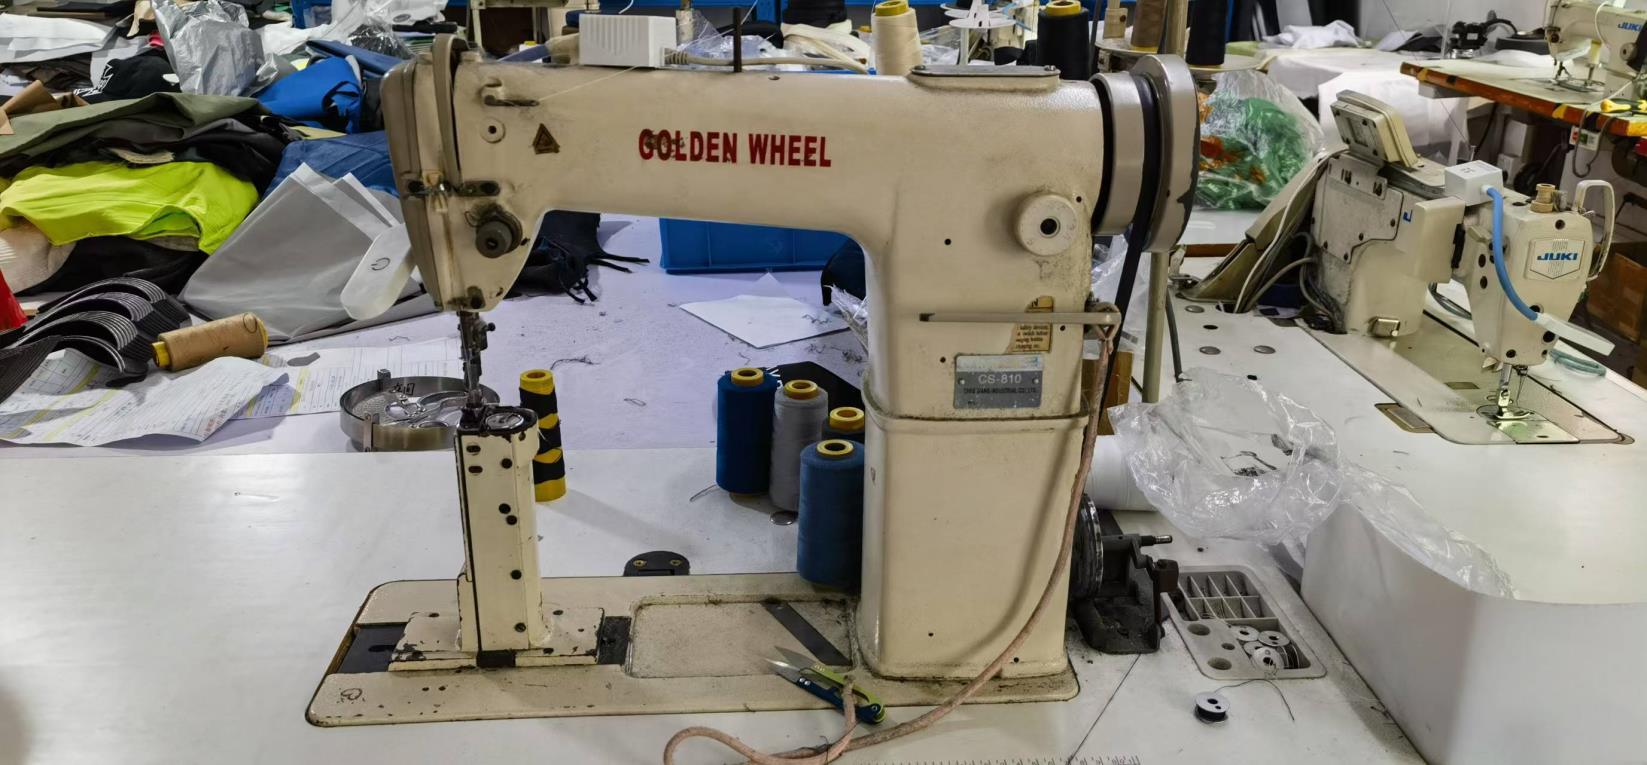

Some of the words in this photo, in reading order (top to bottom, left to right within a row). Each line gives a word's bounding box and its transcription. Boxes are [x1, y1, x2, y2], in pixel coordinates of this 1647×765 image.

[638, 128, 738, 163] GOLDEN
[748, 133, 831, 167] WHEEL
[1537, 252, 1578, 261] JUKI
[978, 374, 1022, 384] CS-810
